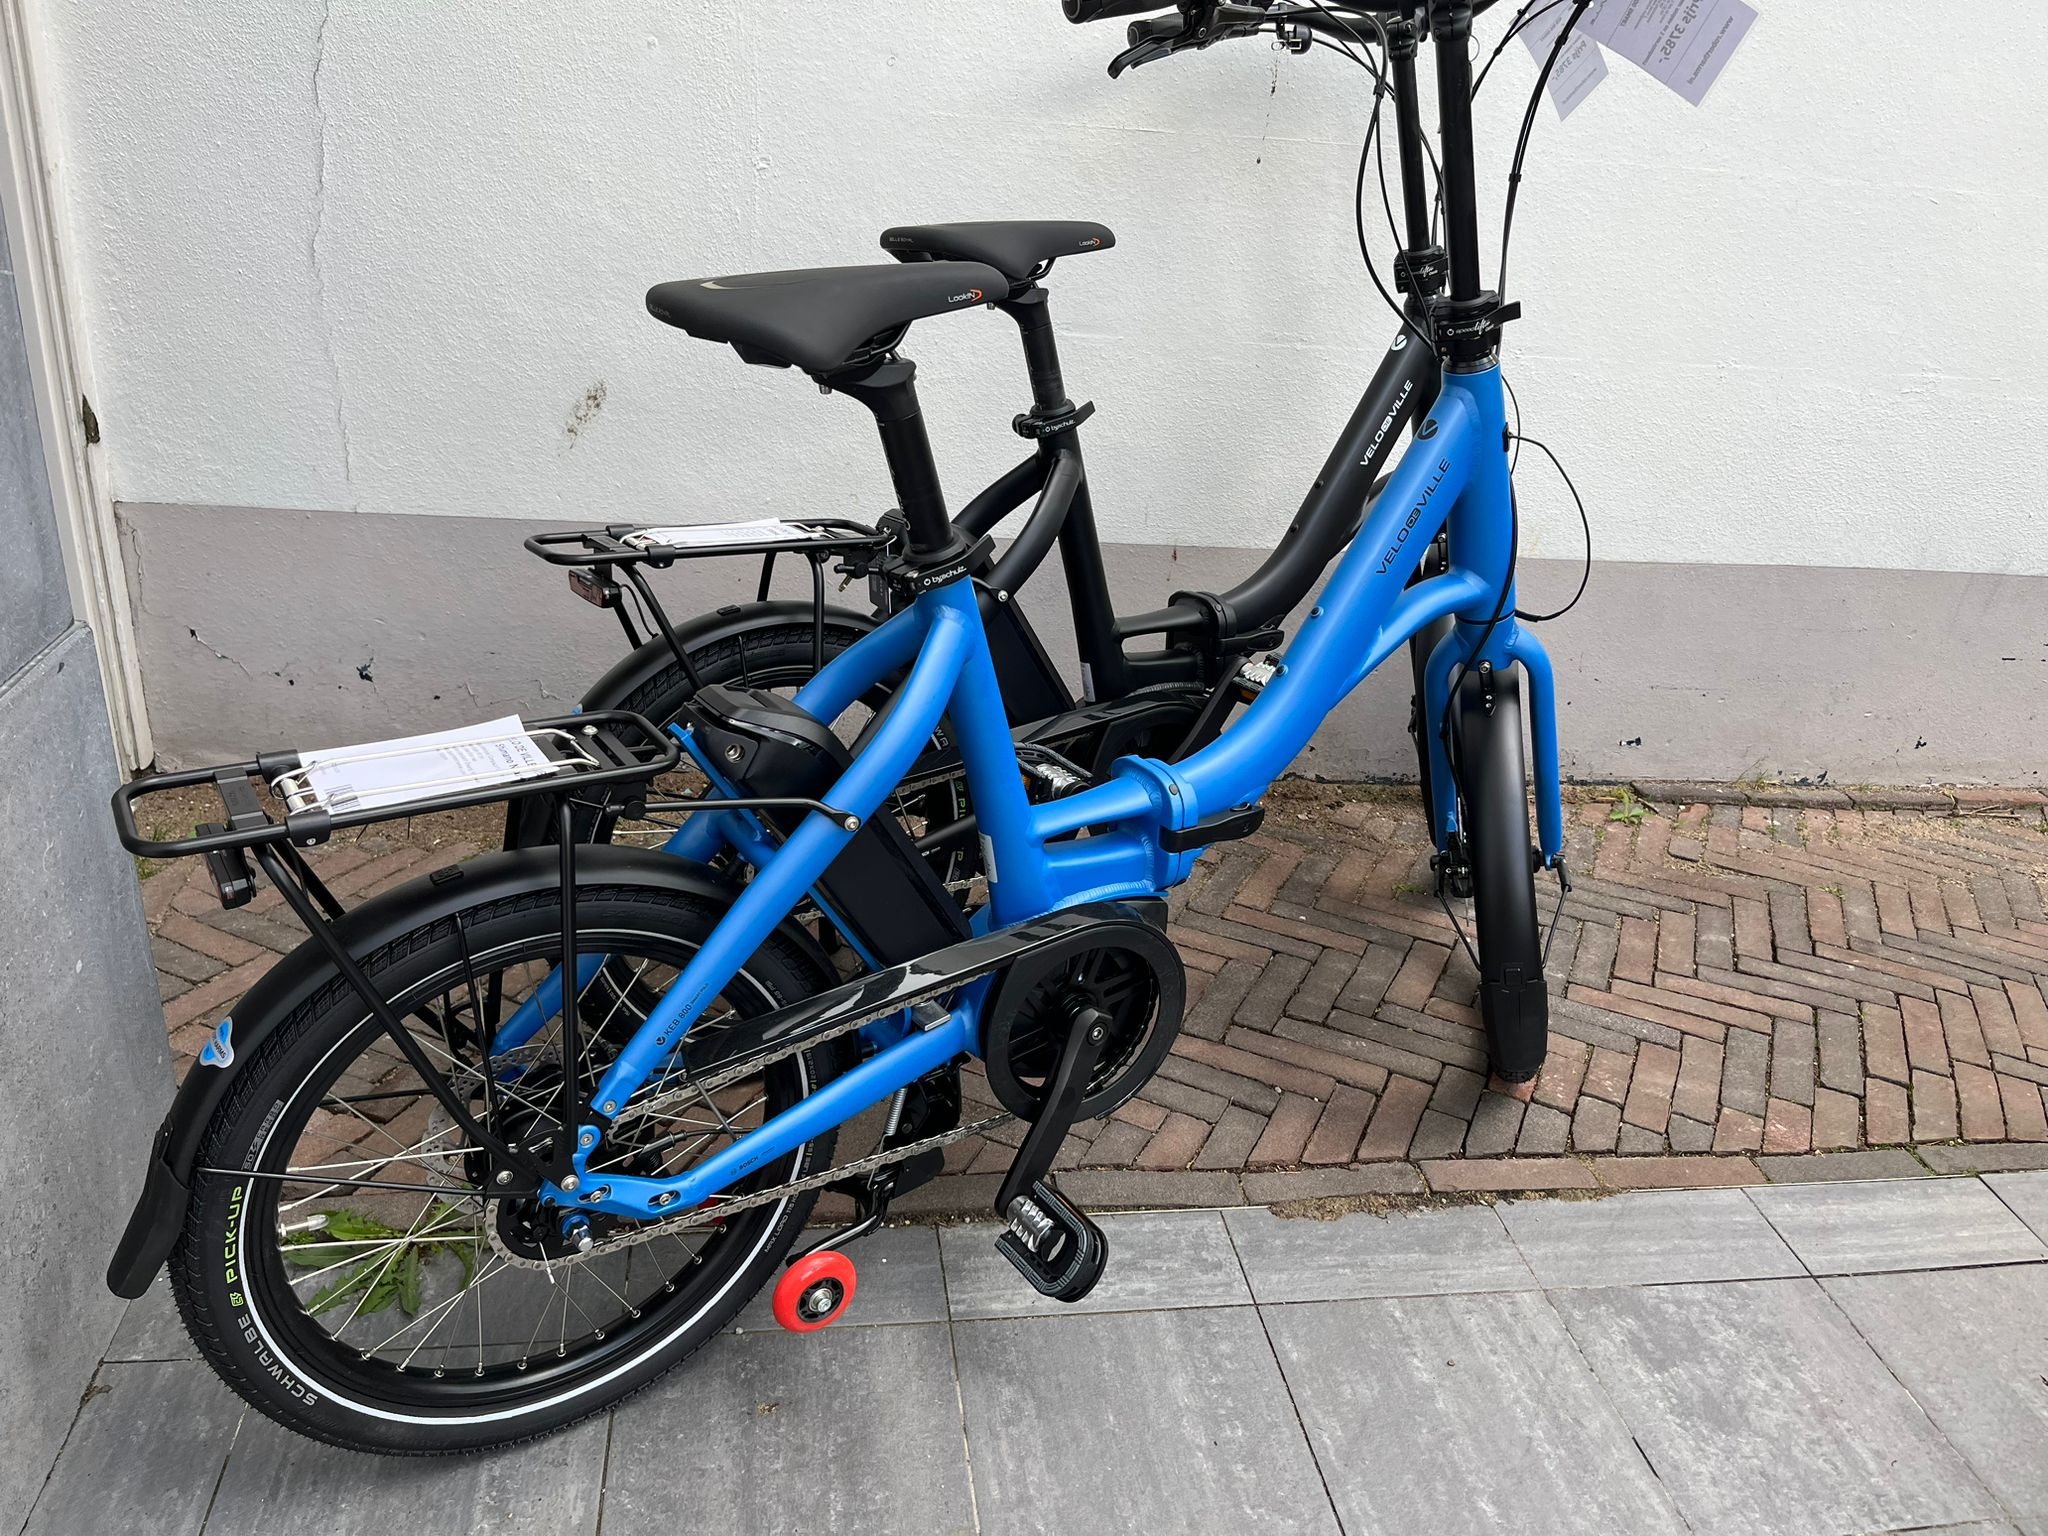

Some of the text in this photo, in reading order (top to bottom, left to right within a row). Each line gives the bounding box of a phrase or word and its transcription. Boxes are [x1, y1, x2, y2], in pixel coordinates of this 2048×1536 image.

[1360, 430, 1385, 466] VELO
[1388, 379, 1413, 417] VILLE
[1376, 527, 1410, 576] VELO
[1416, 457, 1451, 508] VILLE
[664, 1018, 681, 1037] KEB
[739, 1155, 760, 1171] BOSCH
[764, 1234, 777, 1254] MAX
[774, 1215, 790, 1237] LOAD
[224, 1185, 318, 1407] SCHWALBE PICK-UP
